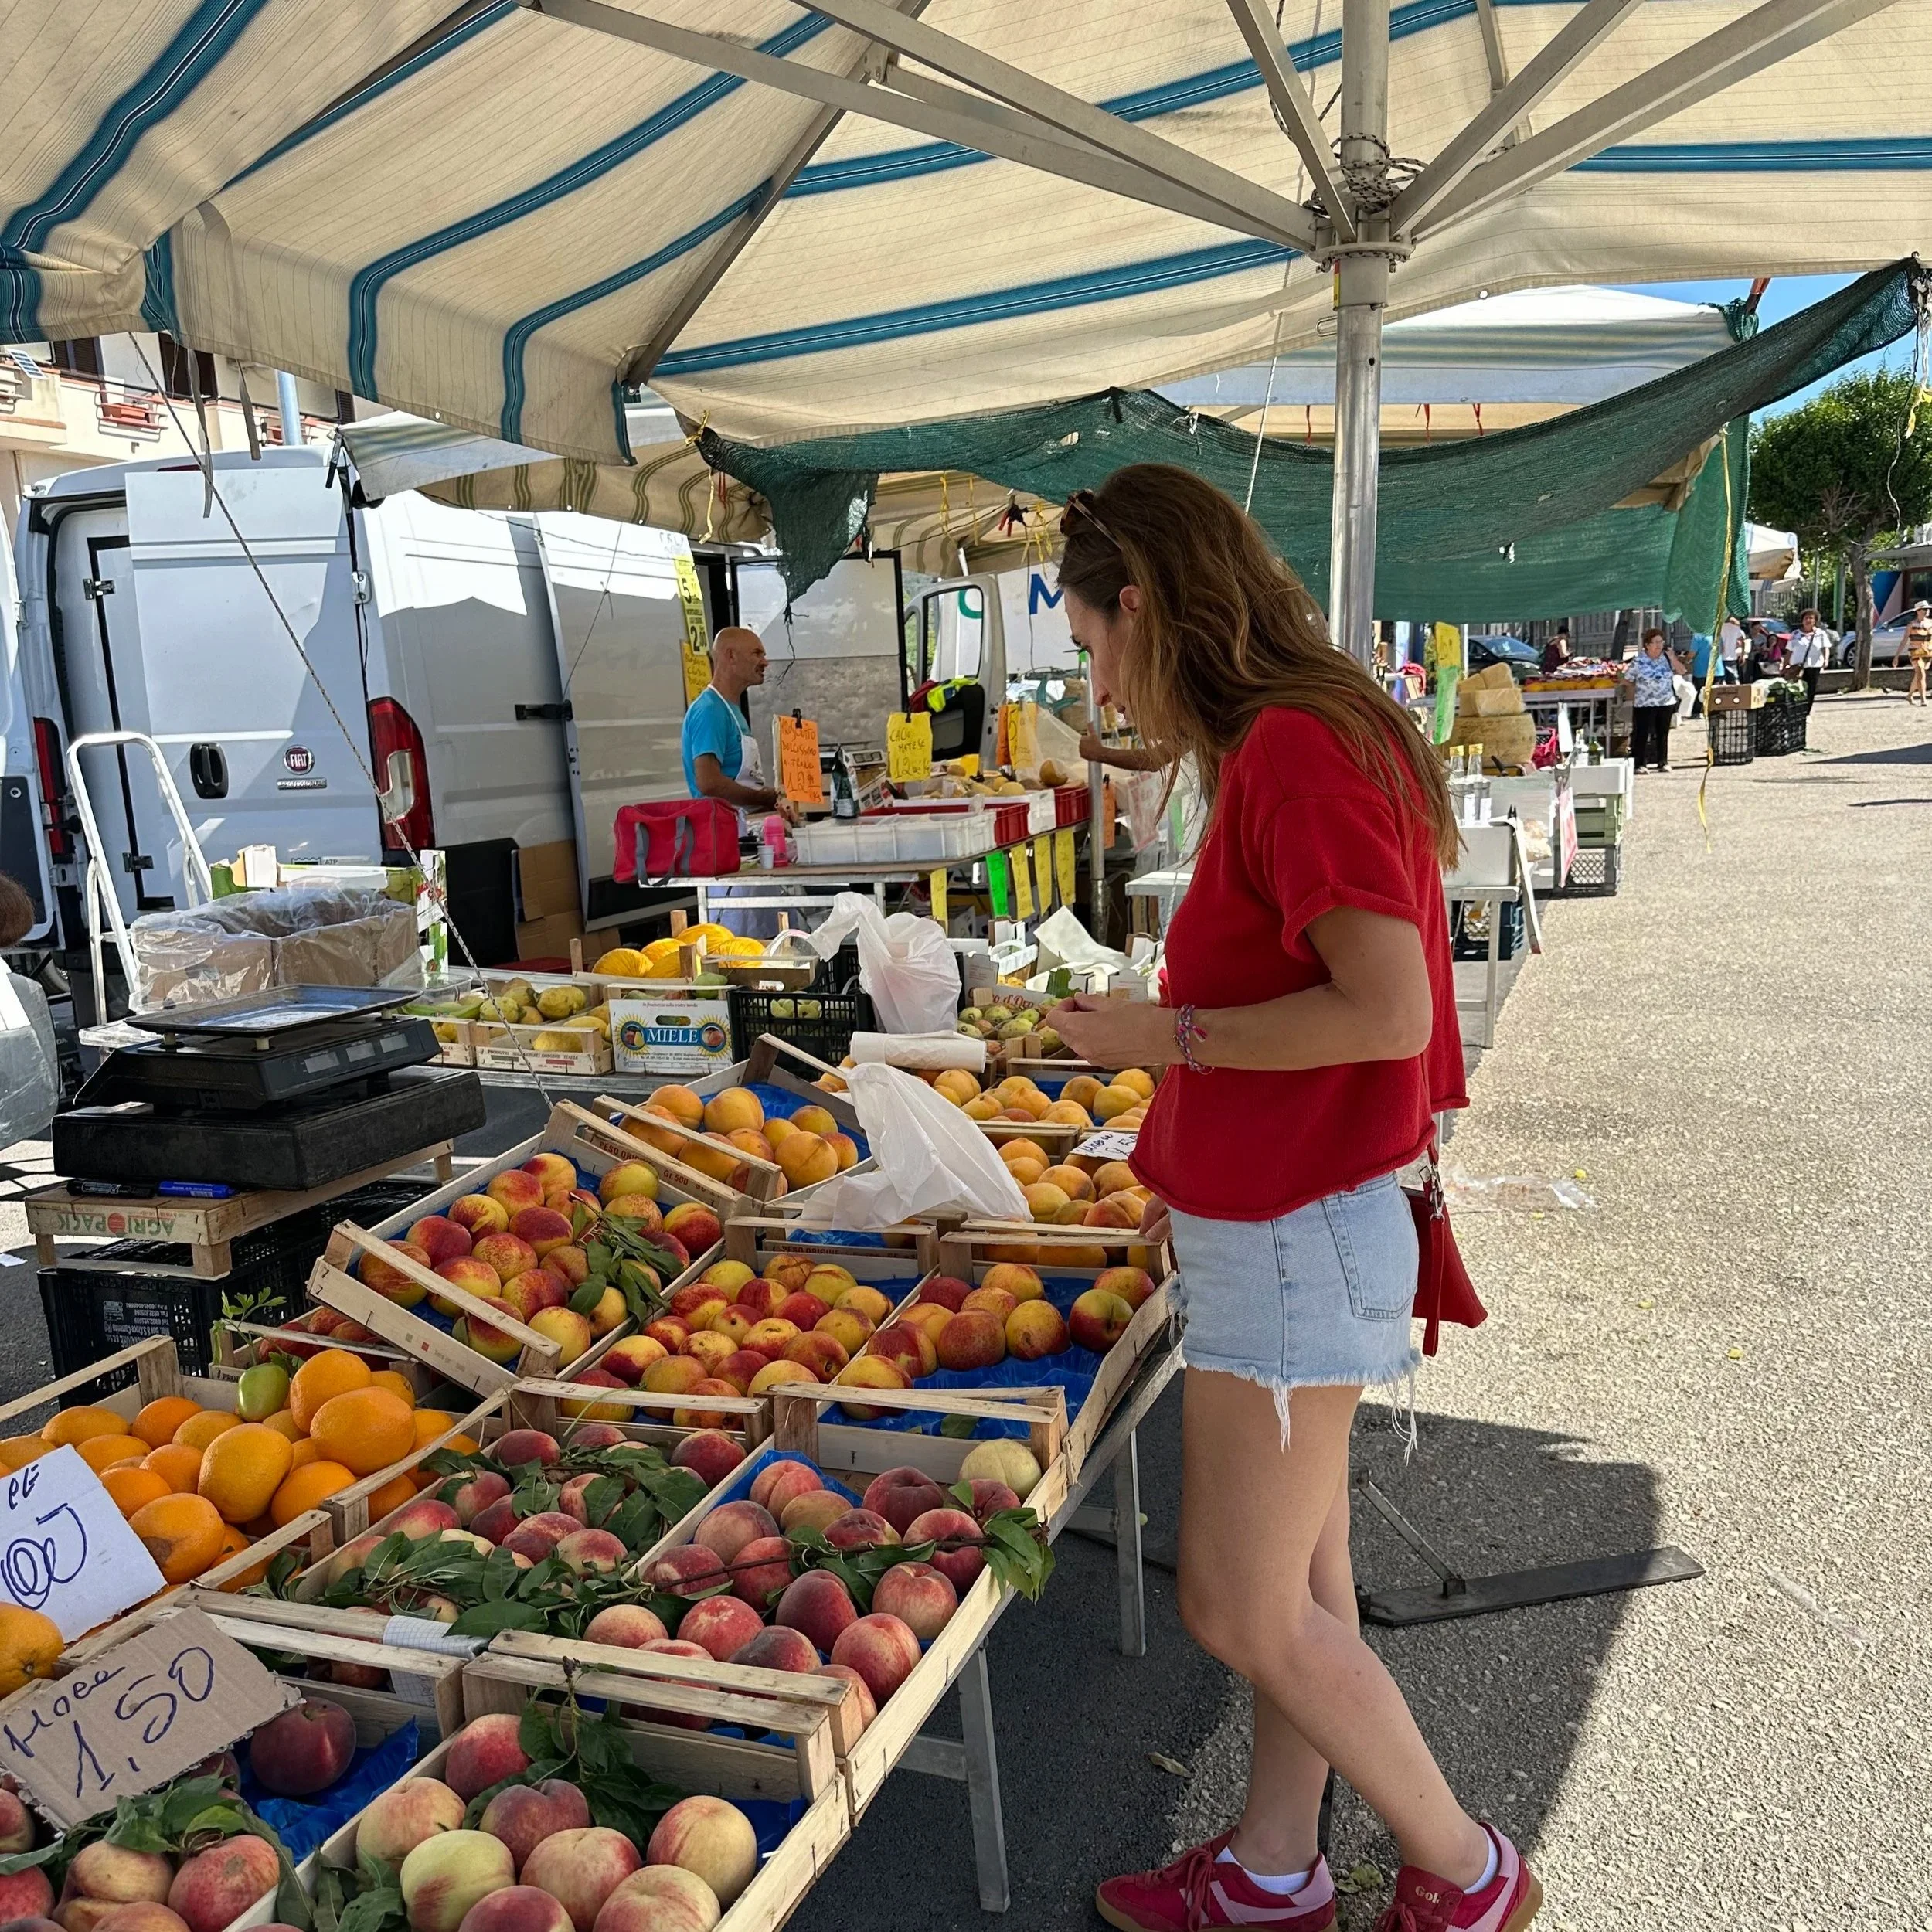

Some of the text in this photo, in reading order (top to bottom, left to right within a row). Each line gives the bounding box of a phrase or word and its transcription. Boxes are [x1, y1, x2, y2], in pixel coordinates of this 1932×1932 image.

[290, 753, 307, 767] FIAT
[647, 1029, 699, 1043] MIELE
[599, 1141, 619, 1156] PESO
